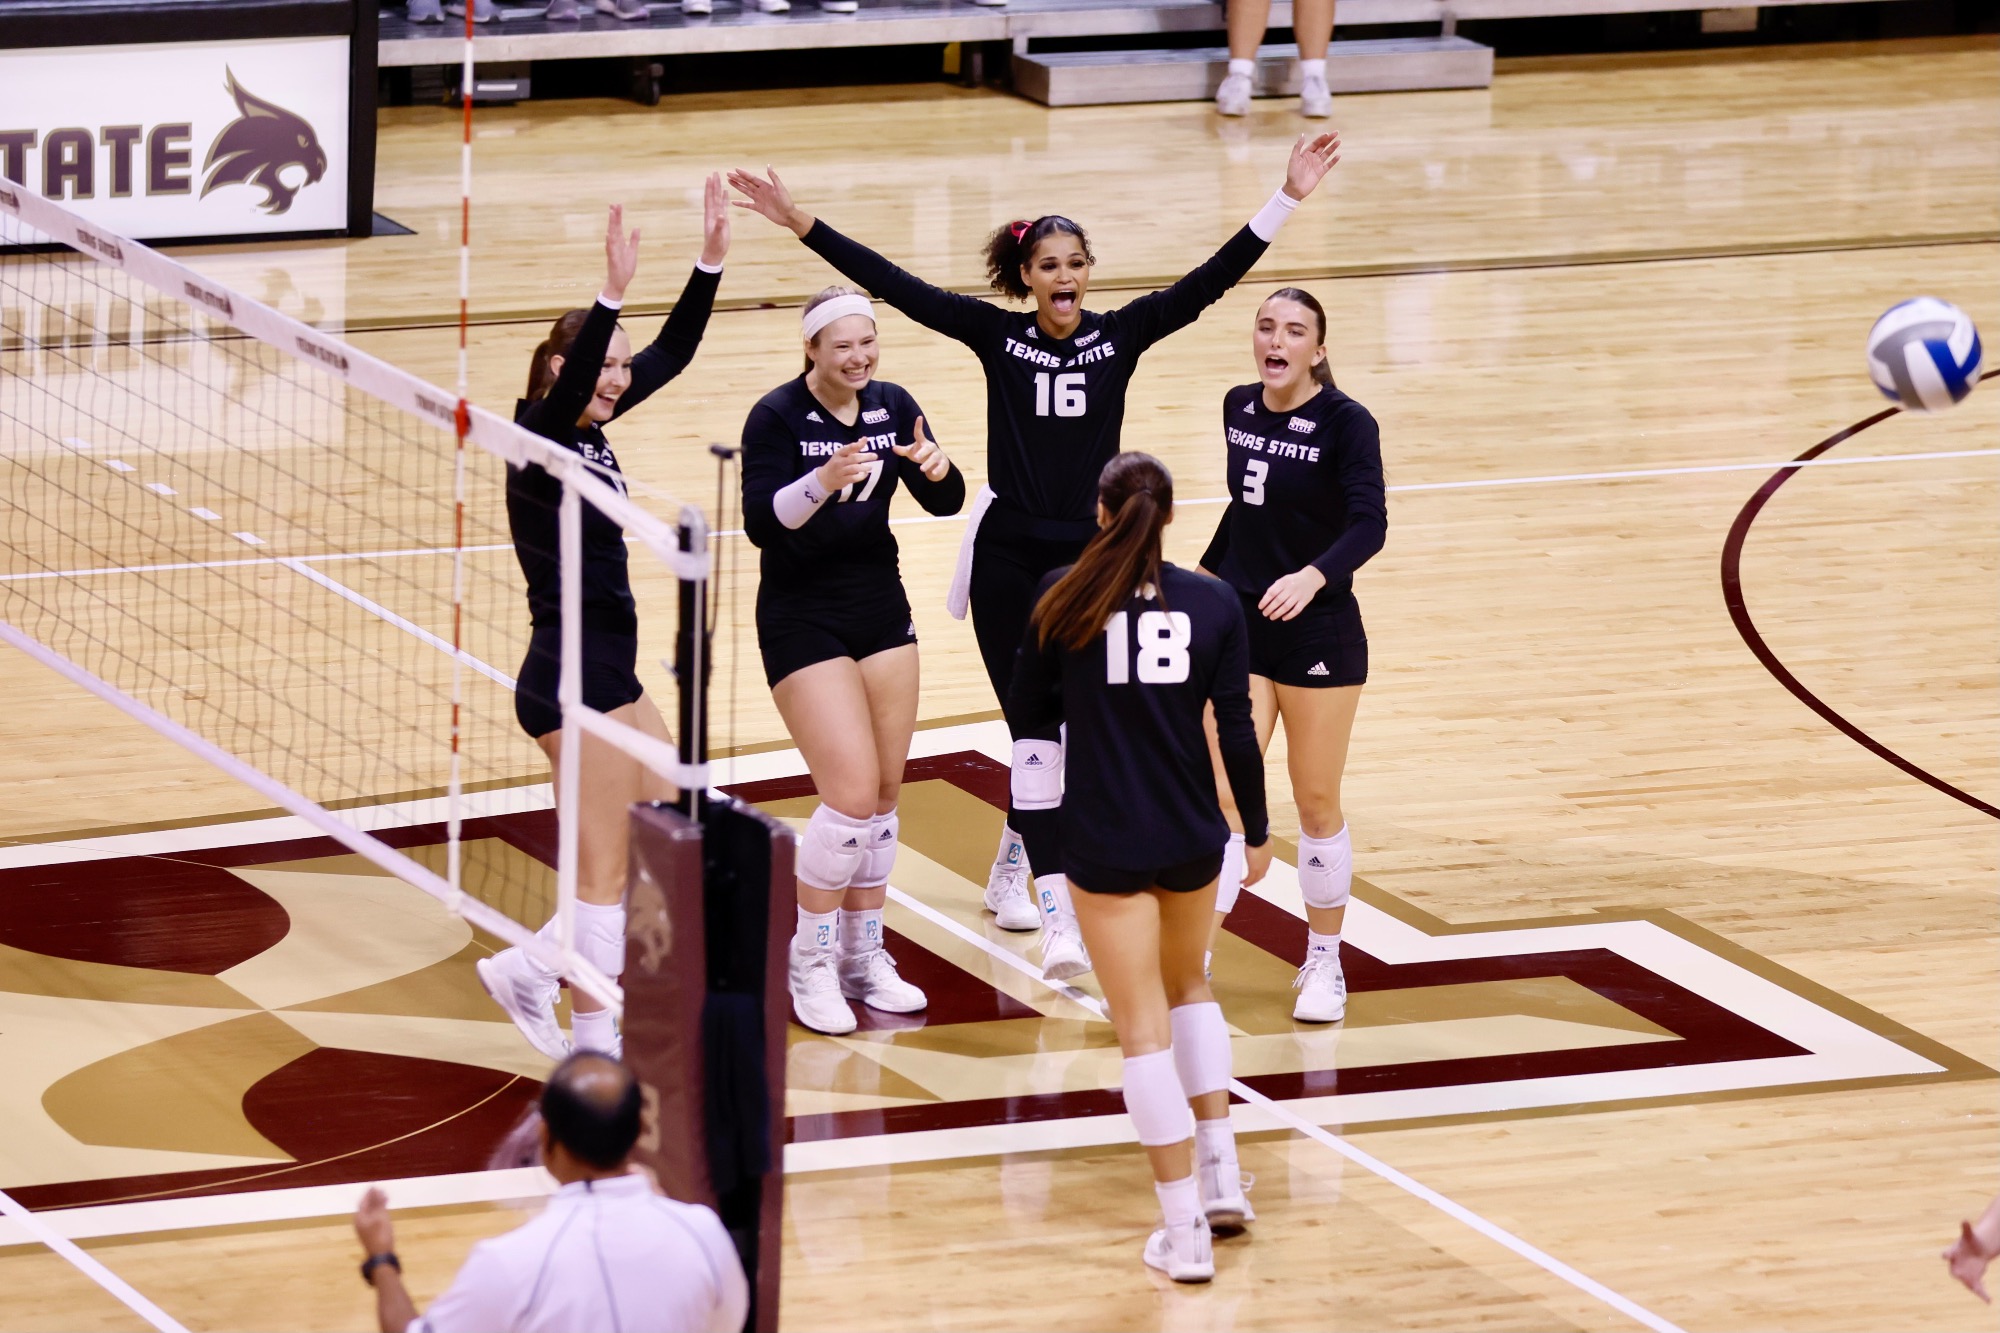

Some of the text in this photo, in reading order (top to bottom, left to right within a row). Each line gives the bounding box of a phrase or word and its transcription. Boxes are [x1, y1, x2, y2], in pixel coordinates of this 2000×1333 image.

[1005, 338, 1061, 368] TEXAS
[1066, 342, 1115, 367] STATE
[1034, 372, 1087, 417] 16
[800, 432, 897, 456] TEXA TAT
[1228, 427, 1320, 463] TEXAS STATE
[1243, 458, 1269, 506] 3
[1102, 610, 1192, 684] 18
